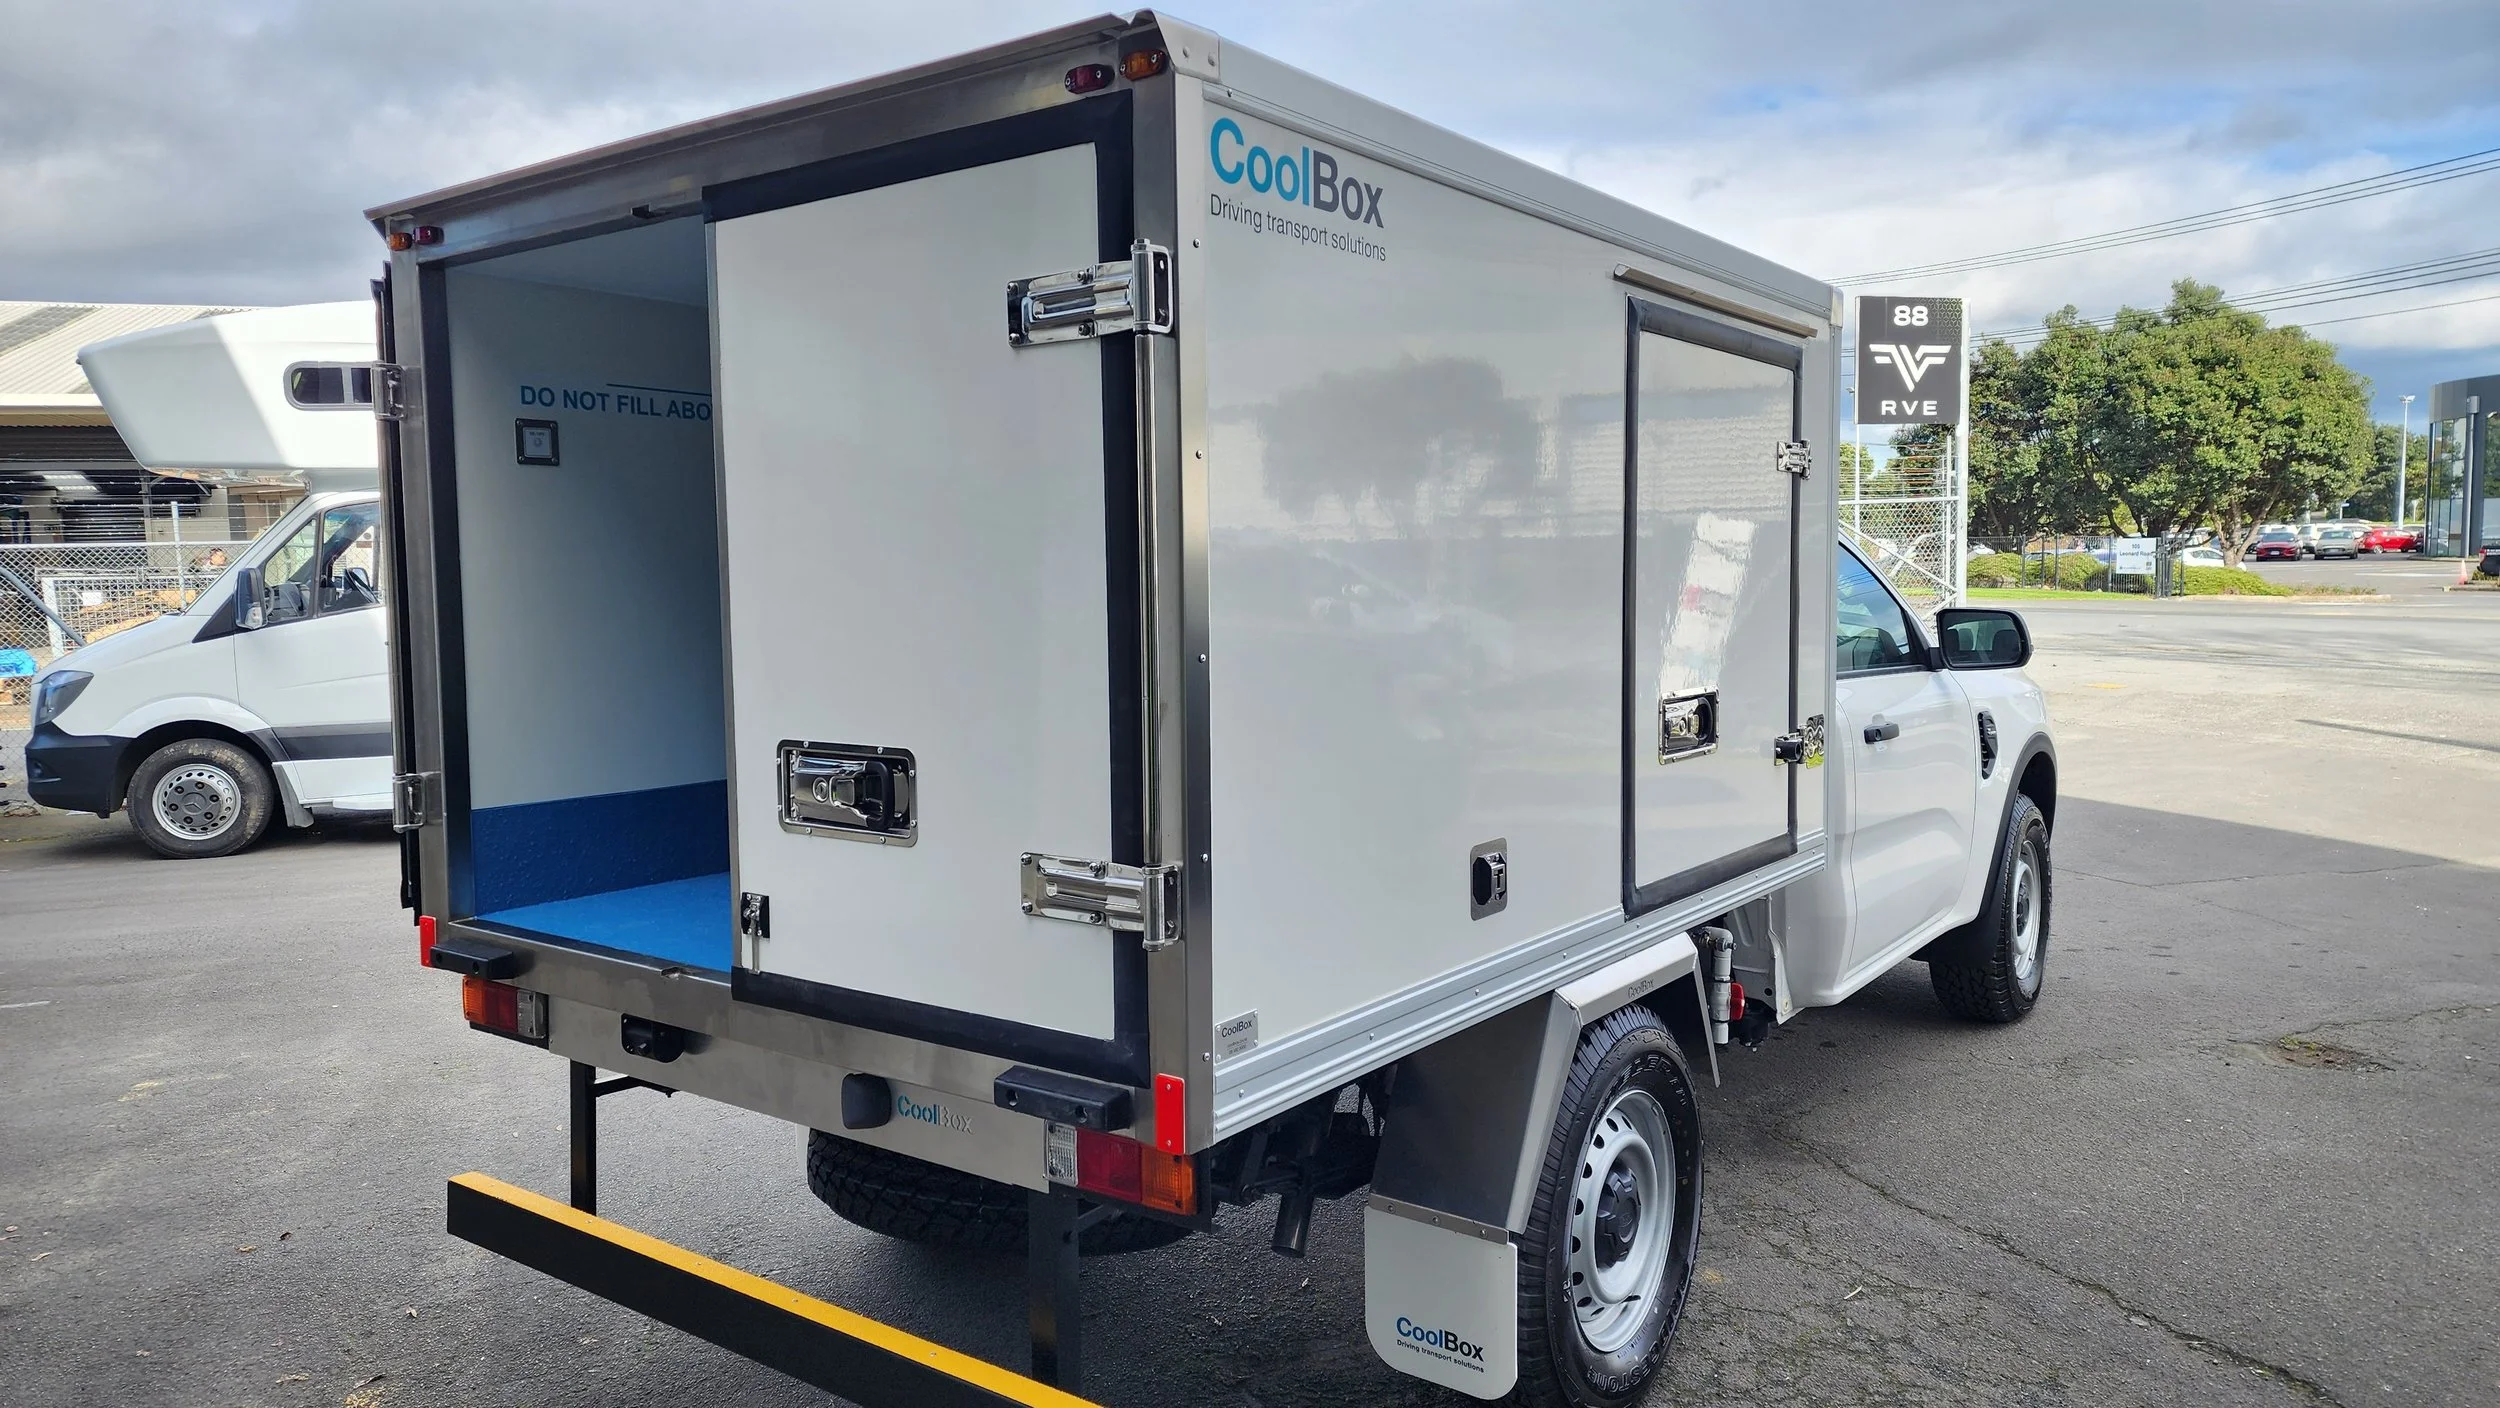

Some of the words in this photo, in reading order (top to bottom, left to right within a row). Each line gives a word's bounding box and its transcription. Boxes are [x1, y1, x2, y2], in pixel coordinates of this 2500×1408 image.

[1210, 117, 1384, 228] CoolBox
[1210, 193, 1262, 233] Driving
[1266, 211, 1328, 245] transport
[1331, 233, 1386, 262] solutions
[1893, 305, 1929, 326] 88
[520, 385, 555, 407] DO
[563, 390, 609, 412] NOT
[616, 395, 661, 416] FILL
[666, 400, 712, 421] ABO
[1881, 400, 1937, 416] RVE
[1221, 1020, 1252, 1038] CoolBox
[897, 1095, 974, 1135] CoolBox
[1396, 1317, 1484, 1362] CoolBox
[1397, 1339, 1420, 1353] Driving
[1421, 1347, 1452, 1362] transport
[1453, 1359, 1484, 1373] solutions
